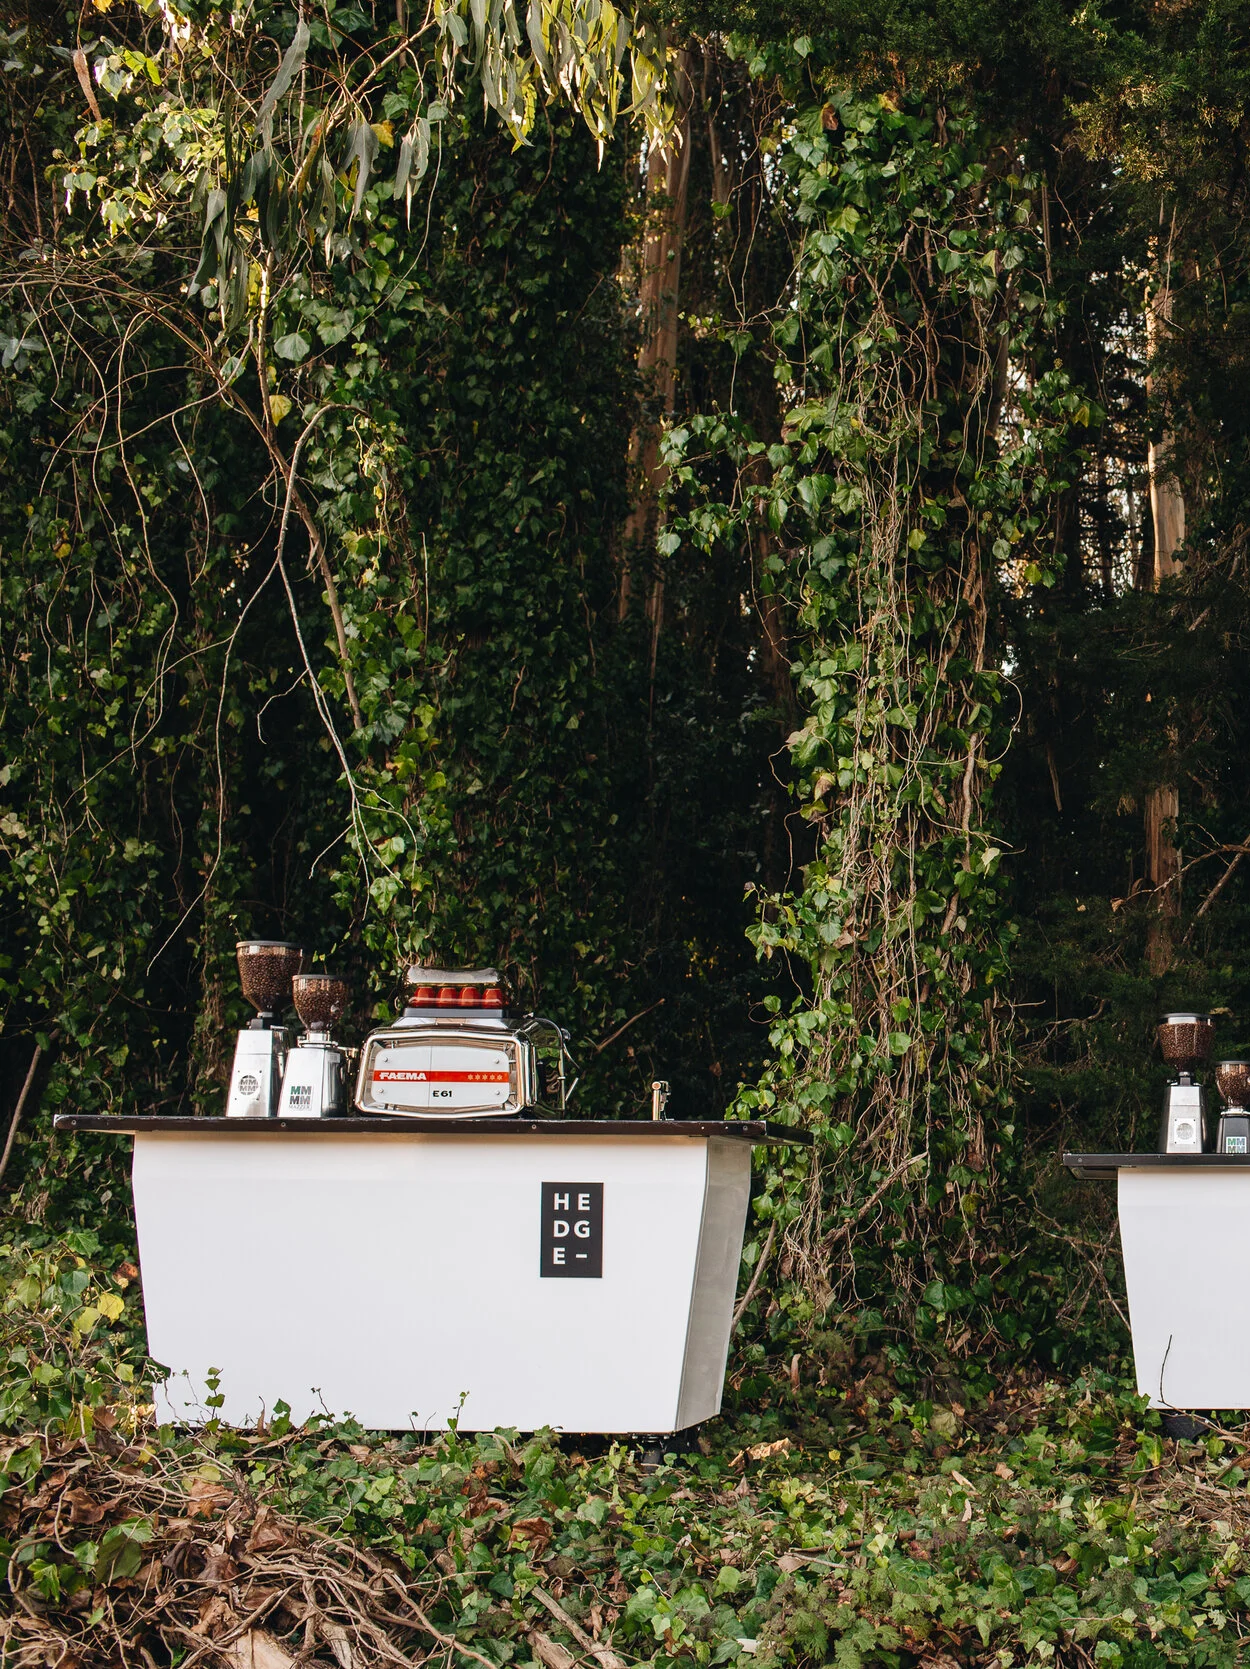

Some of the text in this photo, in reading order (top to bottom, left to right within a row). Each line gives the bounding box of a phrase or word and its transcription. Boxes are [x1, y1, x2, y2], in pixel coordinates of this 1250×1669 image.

[379, 1072, 427, 1081] FAEMA
[290, 1086, 312, 1095] MM
[289, 1095, 311, 1104] MM
[1227, 1138, 1246, 1146] MM
